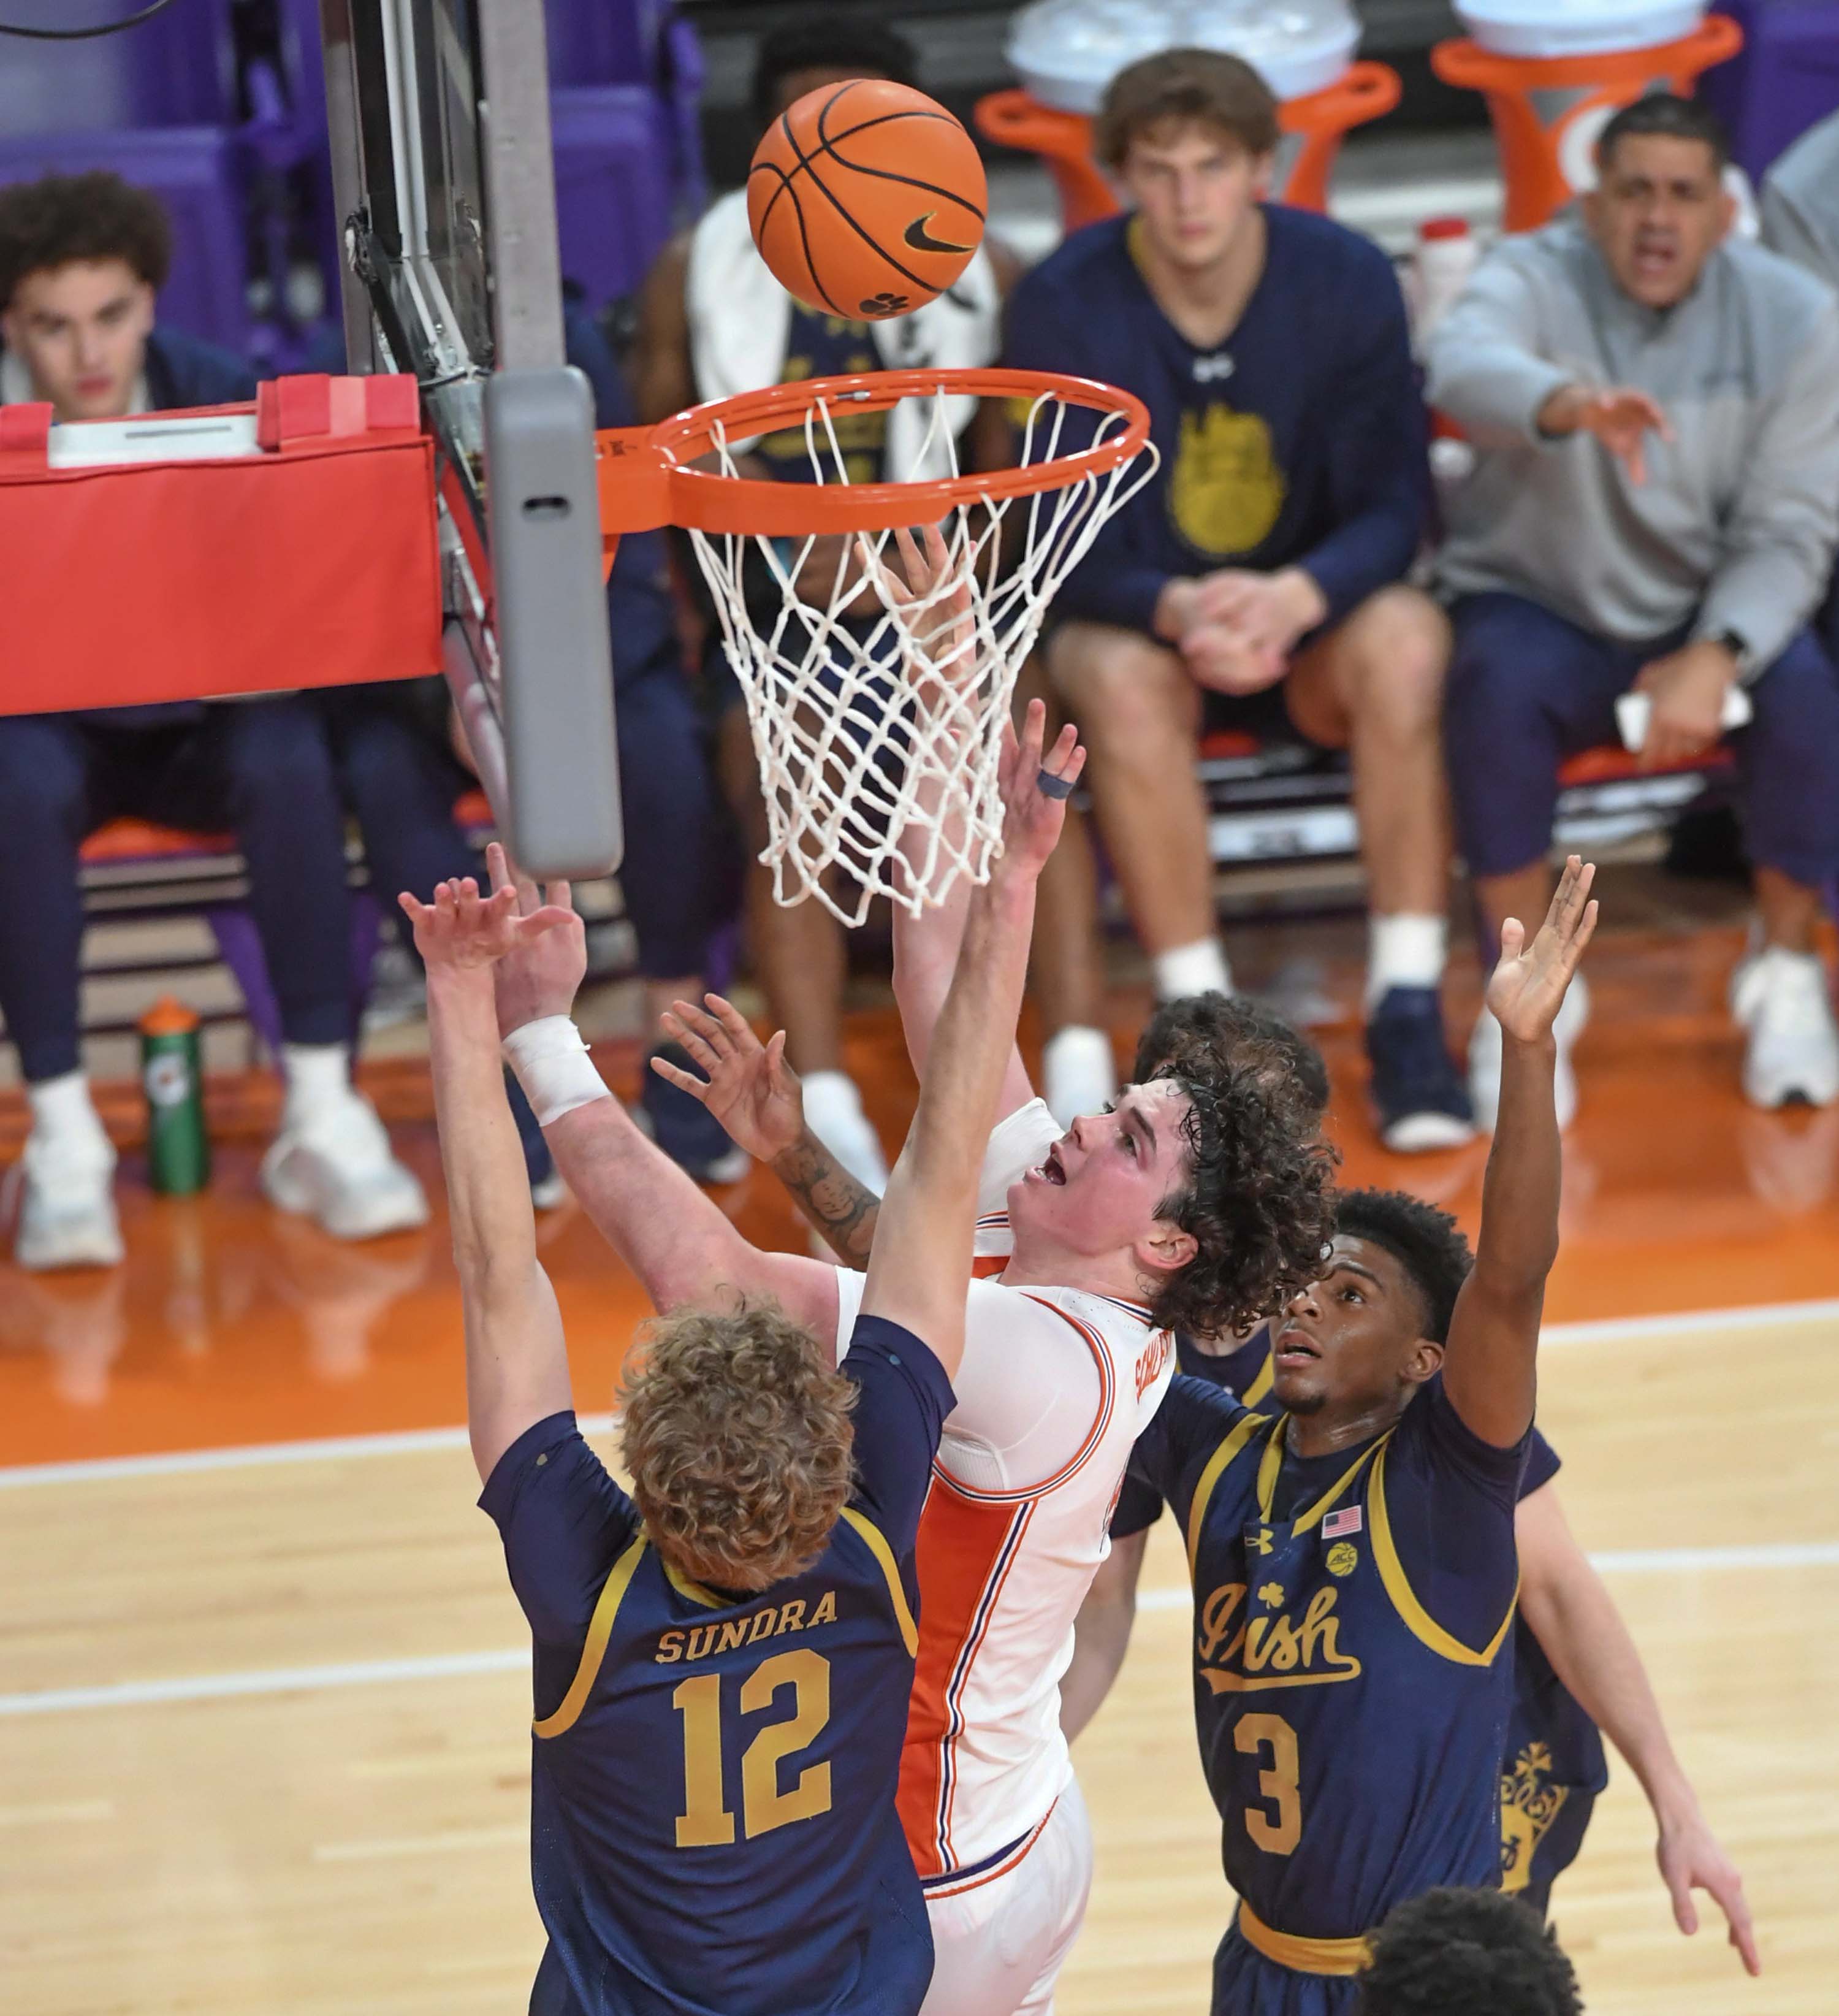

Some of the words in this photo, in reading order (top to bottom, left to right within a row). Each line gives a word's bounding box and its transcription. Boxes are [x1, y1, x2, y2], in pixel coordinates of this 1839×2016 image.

[1330, 1550, 1355, 1564] ACC
[655, 1590, 837, 1664] SUNDRA
[672, 1648, 832, 1848] 12
[1233, 1712, 1302, 1856] 3
